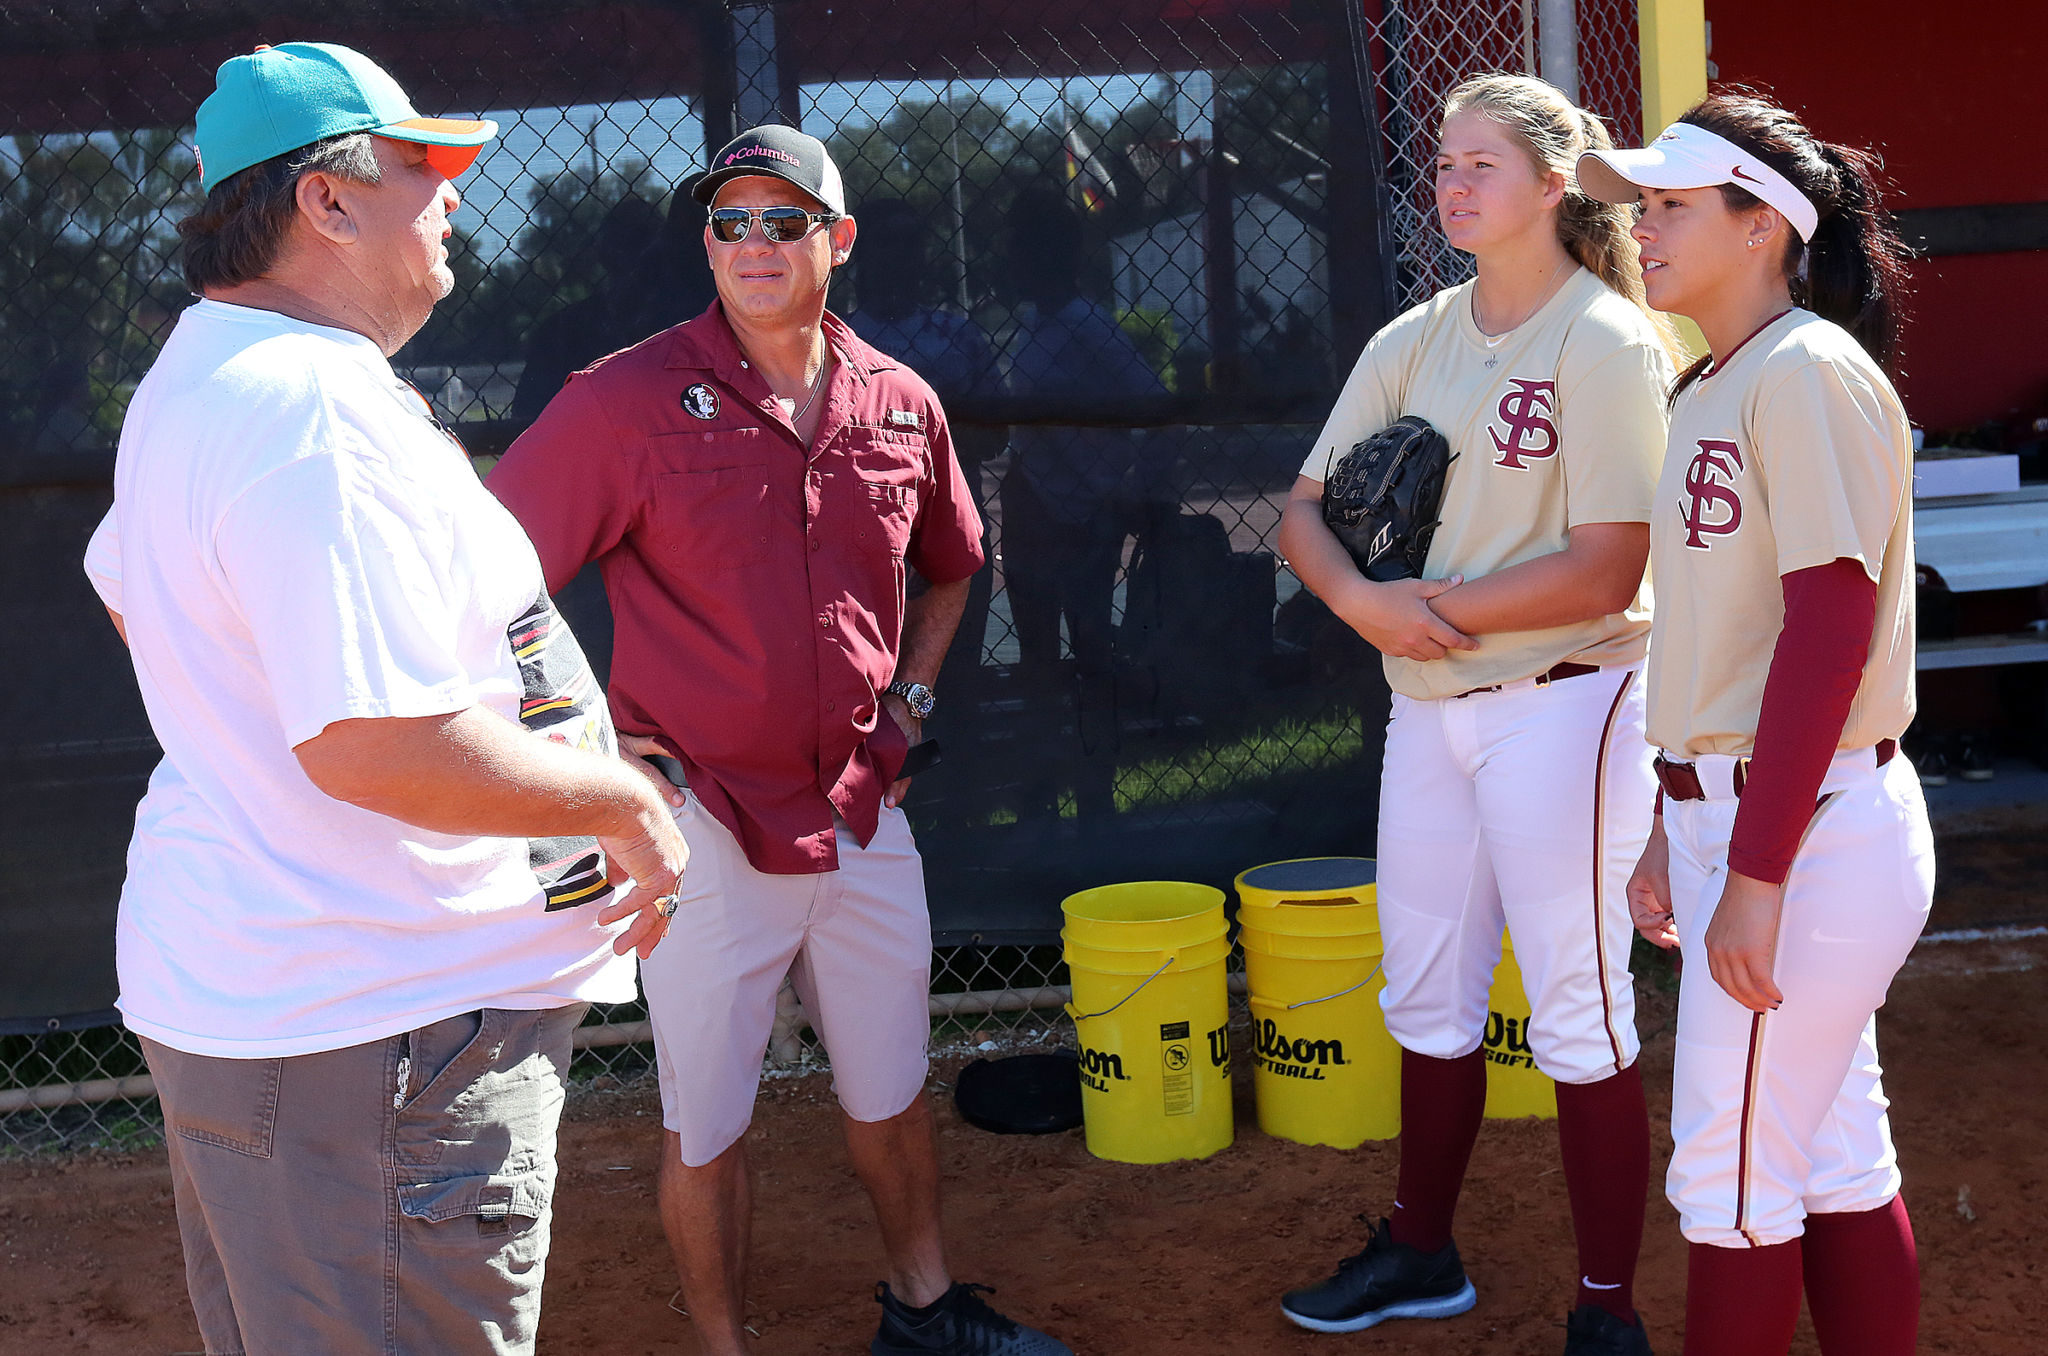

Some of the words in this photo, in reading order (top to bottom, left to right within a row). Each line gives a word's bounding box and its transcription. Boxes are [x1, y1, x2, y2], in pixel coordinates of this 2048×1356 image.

[735, 144, 800, 168] Columbia
[1250, 1011, 1345, 1065] ilson
[1485, 1048, 1538, 1069] SOFT
